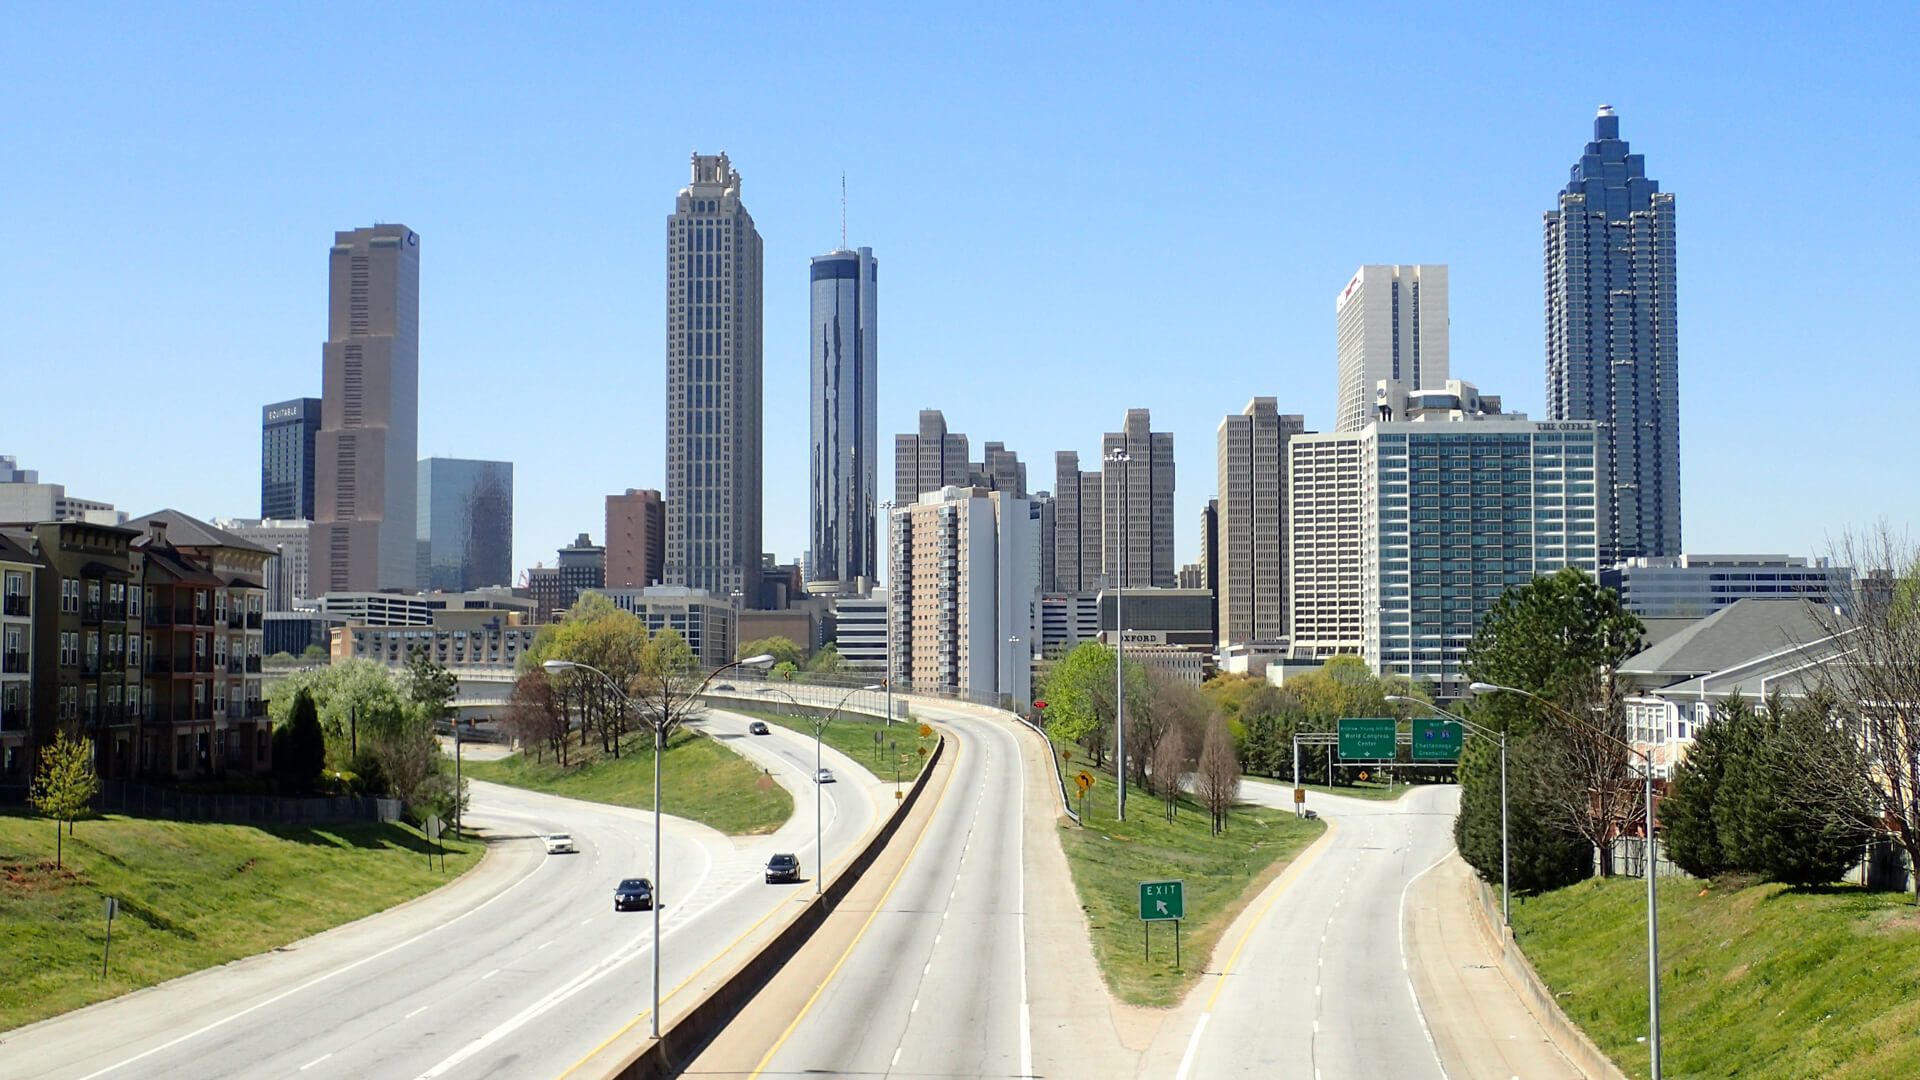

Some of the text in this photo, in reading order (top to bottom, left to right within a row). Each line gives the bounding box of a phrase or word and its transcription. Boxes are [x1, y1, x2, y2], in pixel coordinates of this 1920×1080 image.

[269, 407, 297, 420] EQUITABLE
[1536, 422, 1592, 430] THE OFFICE
[1147, 885, 1176, 896] EXIT
